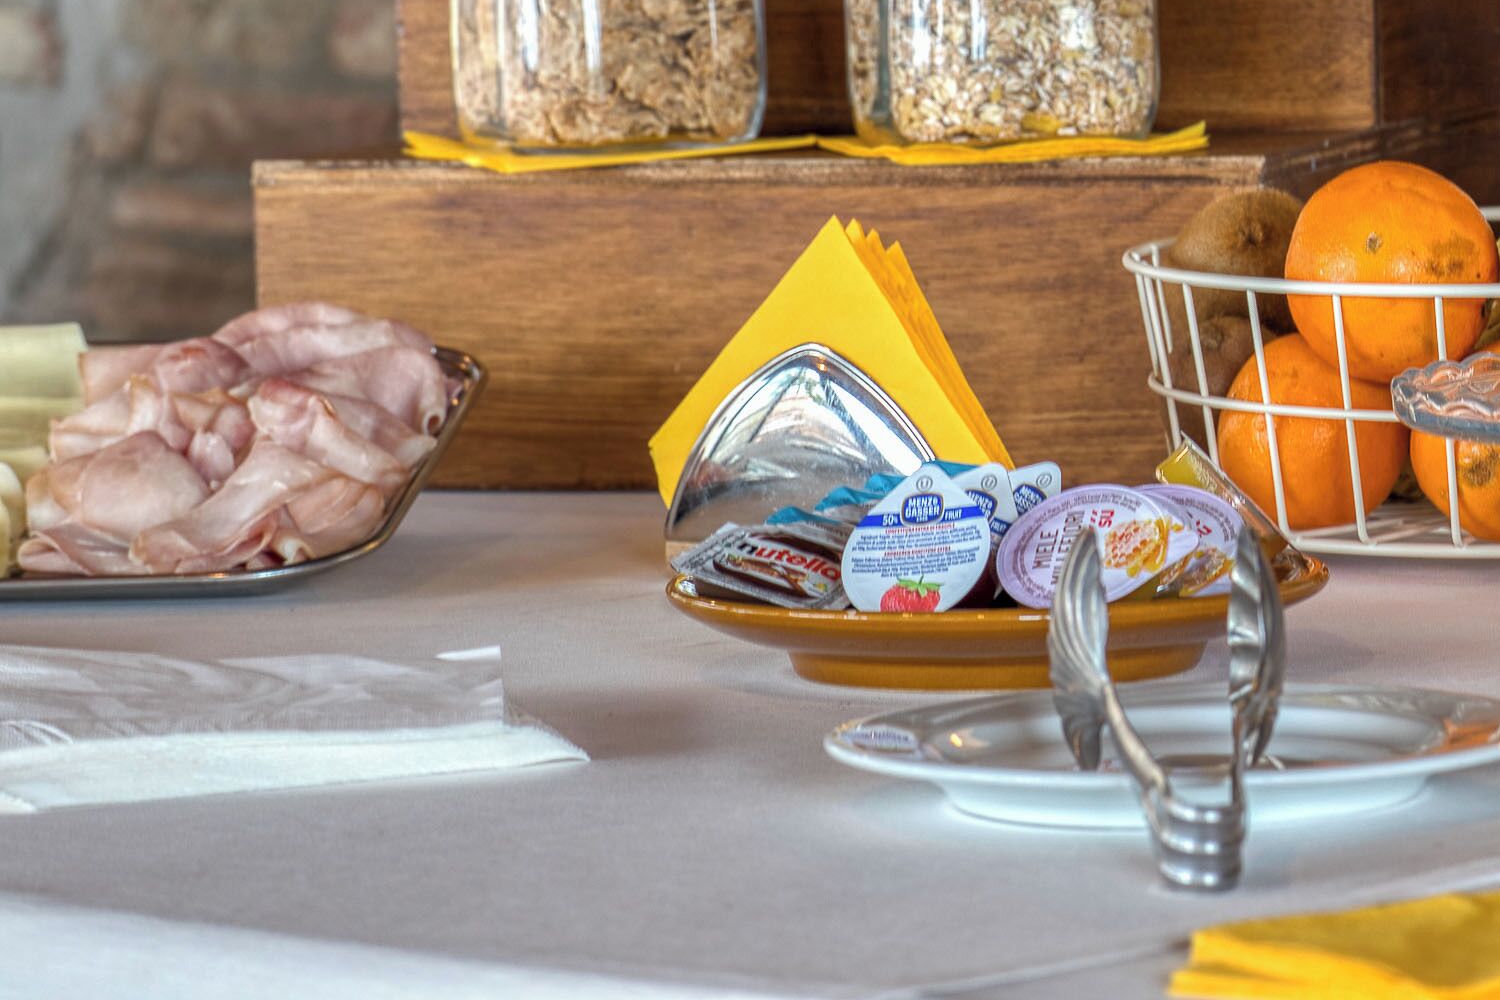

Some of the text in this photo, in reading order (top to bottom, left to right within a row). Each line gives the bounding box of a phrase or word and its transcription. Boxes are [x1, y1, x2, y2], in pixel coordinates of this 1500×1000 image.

[944, 508, 963, 521] FRUIT
[738, 542, 841, 581] nutella
[1032, 529, 1059, 570] MIELE
